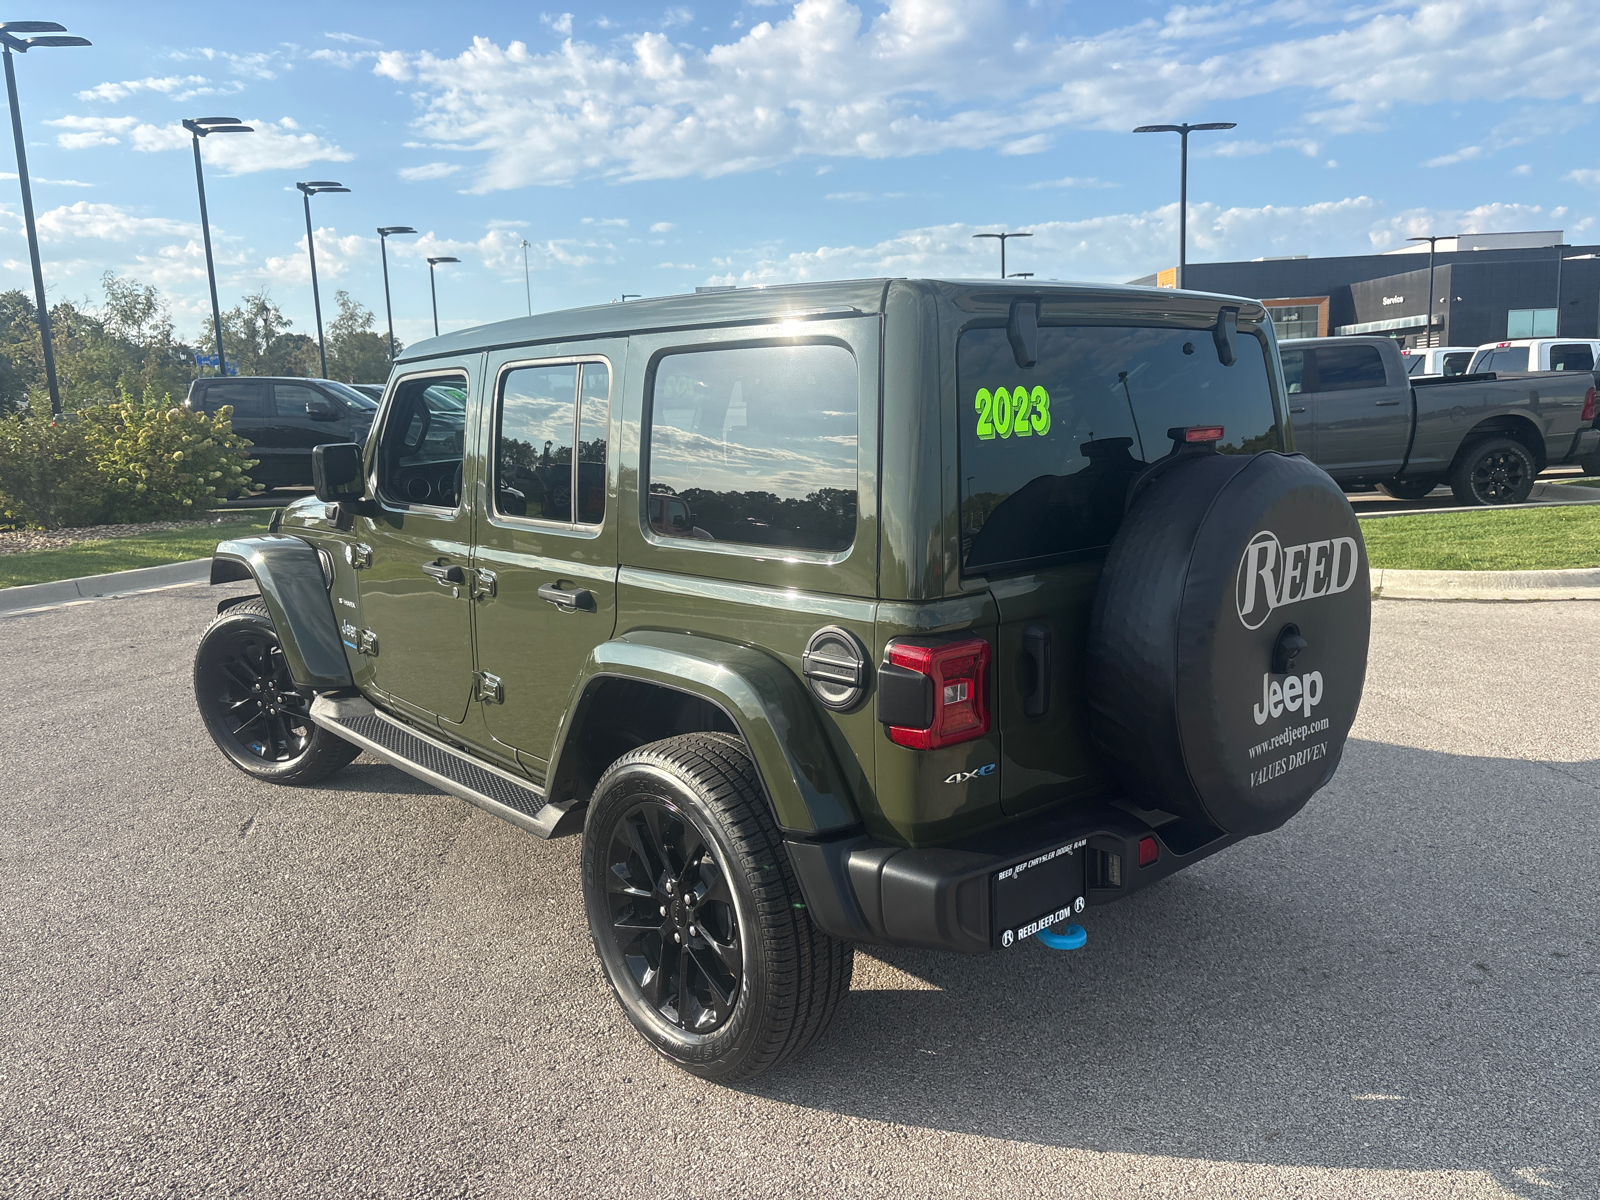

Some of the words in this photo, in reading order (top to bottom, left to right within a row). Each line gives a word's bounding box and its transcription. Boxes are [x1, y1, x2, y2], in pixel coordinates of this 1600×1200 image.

[1382, 295, 1404, 306] Service
[974, 385, 1051, 440] 2023
[1241, 535, 1358, 616] REED
[341, 619, 358, 640] Jee
[1253, 670, 1324, 726] Jeep
[1248, 716, 1330, 759] www.reedjeep.com
[1250, 757, 1287, 788] VALUES
[1288, 741, 1328, 772] DRIVEN
[998, 868, 1013, 881] REED
[1014, 862, 1028, 874] JEEP
[1028, 851, 1056, 868] CHRYSLER
[1055, 843, 1073, 857] DODGE
[1073, 839, 1087, 850] RAM
[1018, 906, 1071, 941] REEDJEEP.COM
